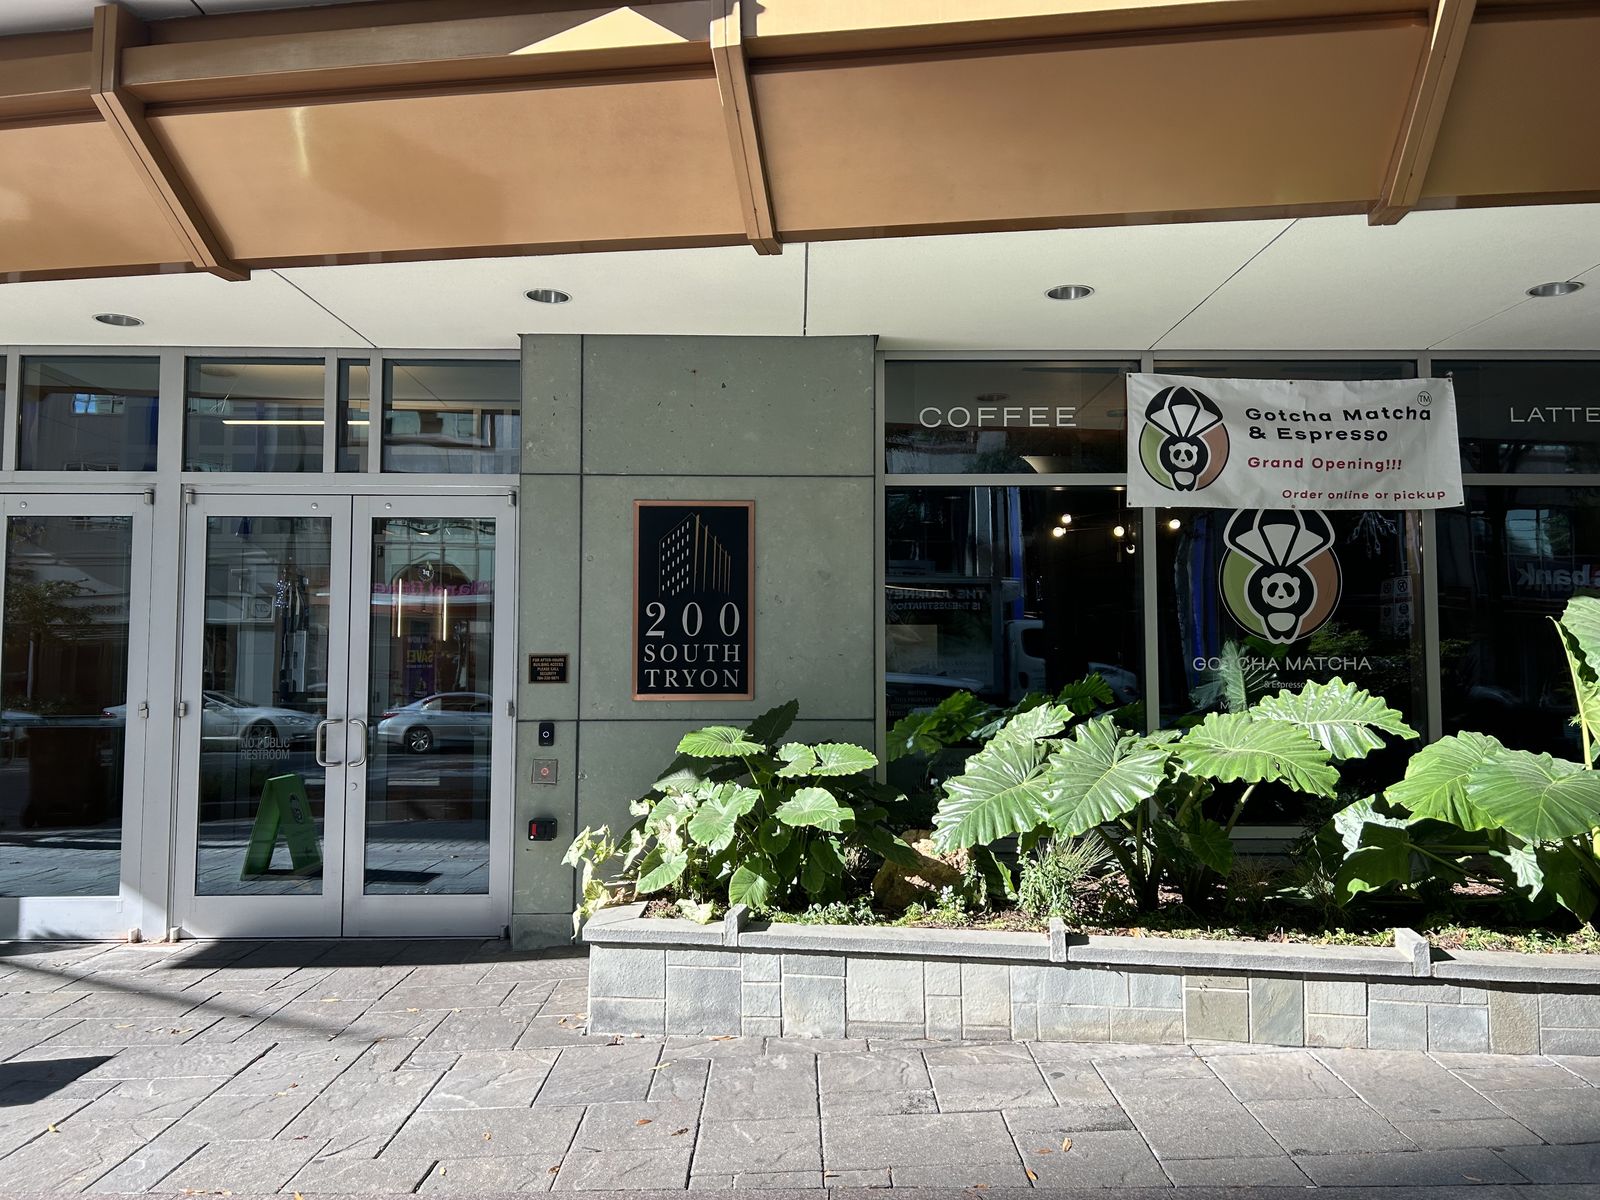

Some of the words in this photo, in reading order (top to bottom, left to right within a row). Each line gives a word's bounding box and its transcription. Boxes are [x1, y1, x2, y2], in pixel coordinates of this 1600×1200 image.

[919, 406, 1077, 428] COFFEE
[1245, 408, 1332, 422] Gotcha
[1342, 406, 1431, 421] Matcha
[1510, 407, 1600, 422] LATTE
[1249, 426, 1267, 440] &
[1277, 427, 1388, 443] Espresso
[1247, 457, 1304, 468] Grand
[1312, 457, 1402, 472] Opening!!!
[1282, 489, 1323, 499] Order
[1328, 490, 1369, 500] online
[1375, 491, 1389, 499] or
[1393, 489, 1446, 501] pickup
[645, 602, 740, 639] 200
[643, 643, 741, 663] SOUTH
[1192, 656, 1280, 671] GOCHA
[1286, 656, 1372, 671] MATCHA
[644, 668, 740, 688] TRYON
[241, 737, 255, 748] NO
[257, 737, 290, 748] PUBLIC
[241, 749, 290, 760] RESTROOM
